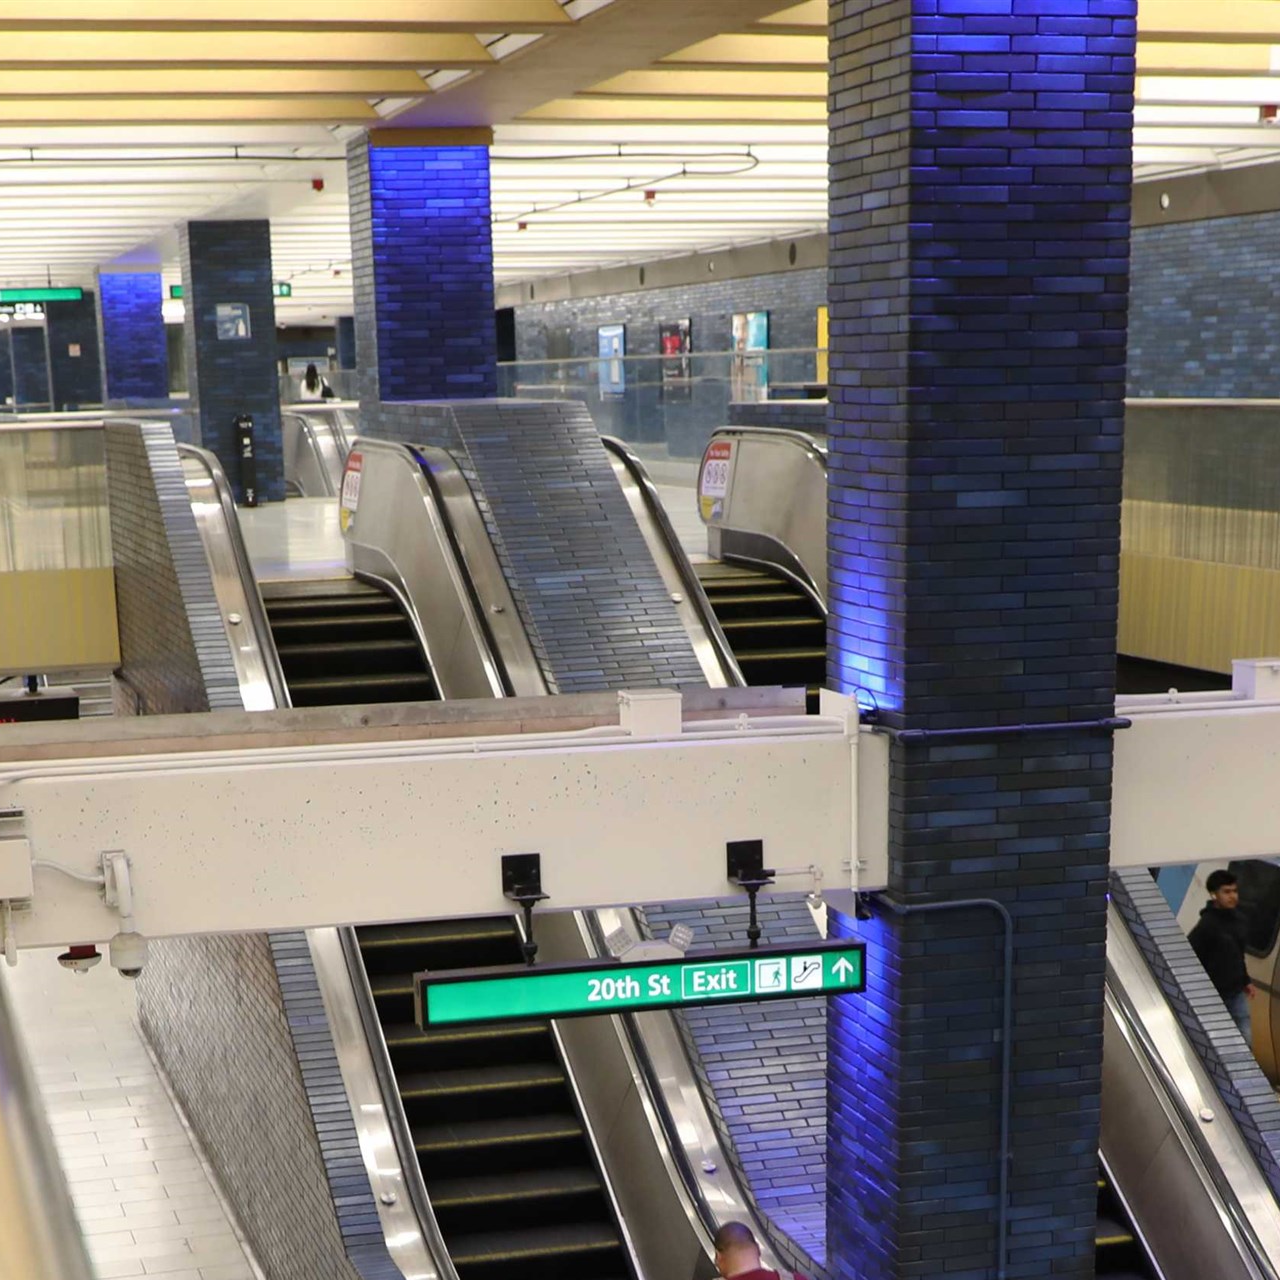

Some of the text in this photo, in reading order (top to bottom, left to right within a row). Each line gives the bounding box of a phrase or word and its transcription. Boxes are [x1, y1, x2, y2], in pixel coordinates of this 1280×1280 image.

[587, 970, 737, 1001] 20th St Exit
